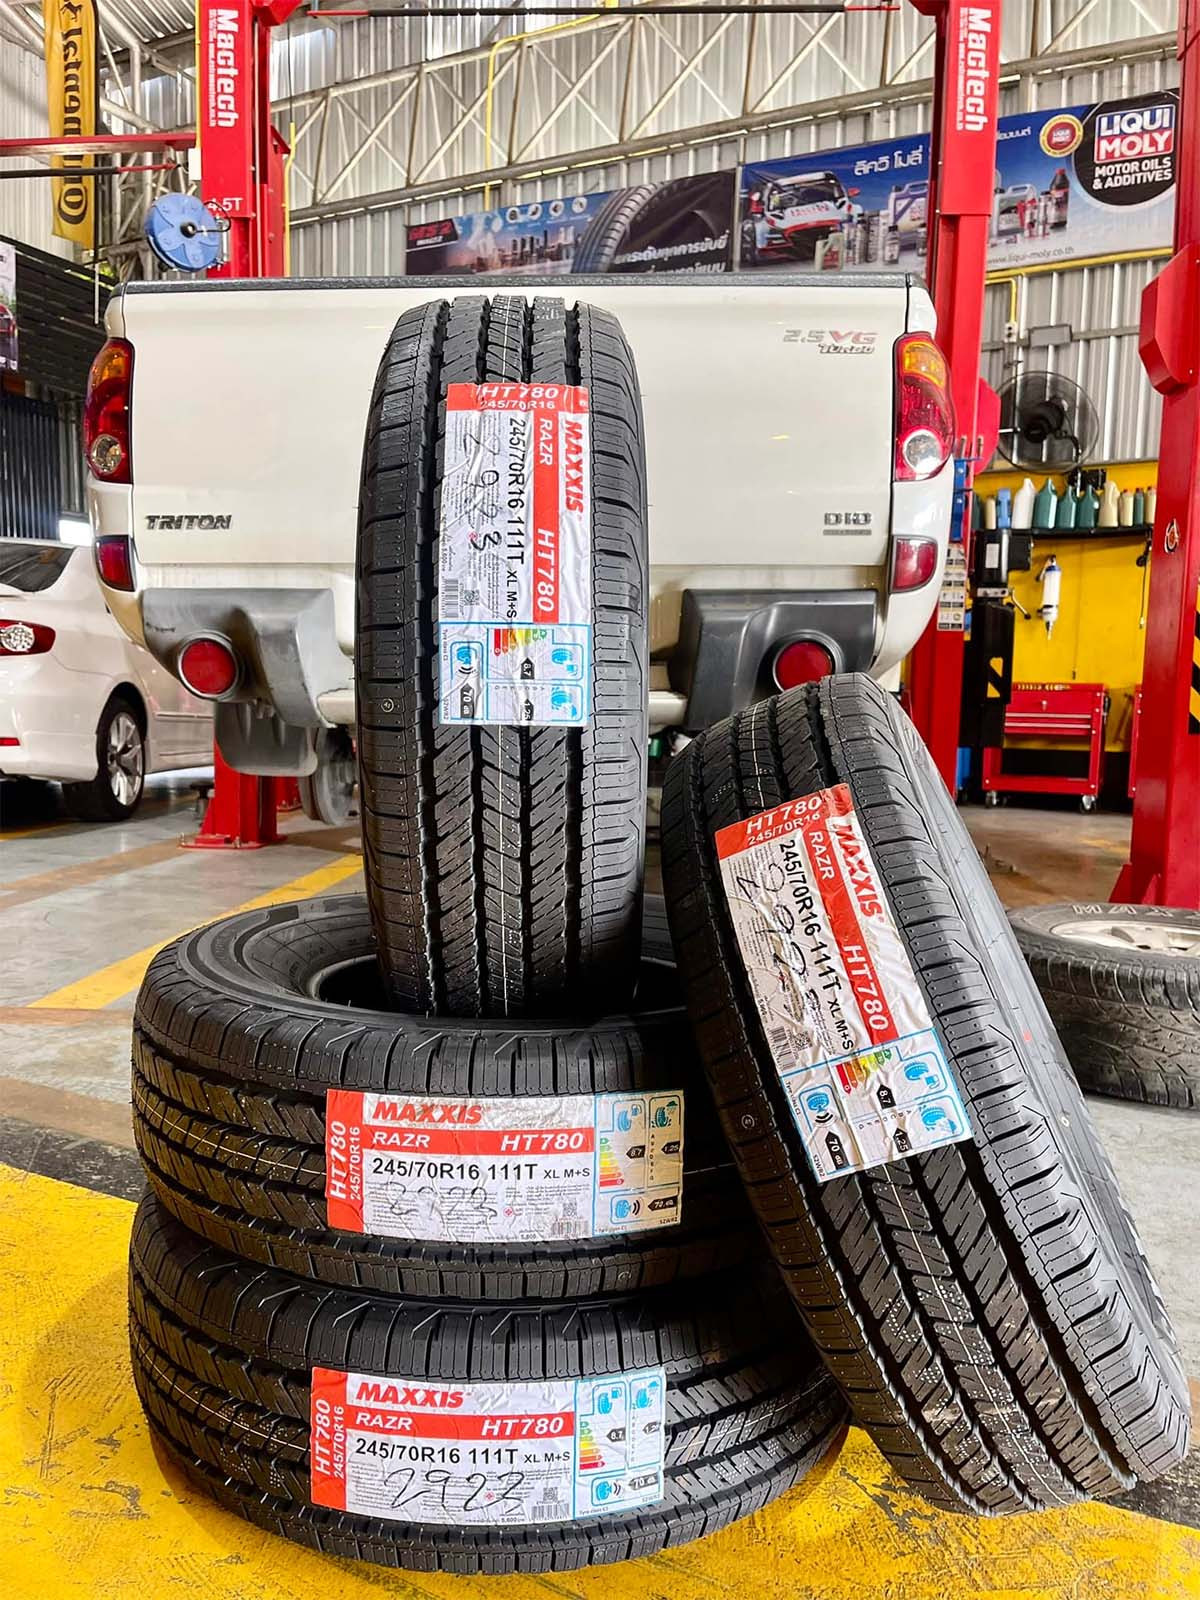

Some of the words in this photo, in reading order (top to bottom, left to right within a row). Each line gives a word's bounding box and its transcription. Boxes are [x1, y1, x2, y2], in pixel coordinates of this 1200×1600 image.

[216, 9, 239, 127] Mactech
[964, 8, 992, 131] Mactech
[1100, 108, 1171, 136] LIQUI
[1100, 130, 1172, 160] MOLY
[1092, 178, 1103, 190] &
[1104, 169, 1172, 188] ADDITIVES
[1095, 161, 1140, 178] MOTOR
[1141, 157, 1172, 170] OILS
[481, 386, 559, 399] HT780
[539, 418, 553, 465] RAZR
[507, 418, 526, 509] 245/70R16
[565, 420, 584, 513] MAXXIS
[145, 514, 233, 530] TRITON
[507, 516, 525, 564] 111T
[506, 570, 517, 586] XL
[537, 528, 555, 612] HT780
[506, 591, 517, 618] M+S
[462, 691, 472, 703] 70
[746, 796, 823, 835] HT780
[747, 812, 821, 845] 245/70R16
[834, 823, 883, 918] MAXXIS
[780, 839, 822, 937] 245/70R16
[808, 831, 836, 880] RAZR
[843, 945, 889, 1030] HT780
[811, 941, 842, 991] 111T
[828, 998, 842, 1018] XL
[834, 1020, 854, 1050] M+S
[879, 1089, 891, 1104] 8.7
[372, 1101, 483, 1125] MAXXIS
[372, 1131, 431, 1148] RAZR
[500, 1132, 584, 1151] HT780
[828, 1138, 839, 1152] 70
[894, 1131, 908, 1151] 1.25
[330, 1120, 347, 1199] HT780
[349, 1126, 361, 1200] 245/70R16
[372, 1157, 480, 1180] 245/70R16
[487, 1163, 538, 1181] 111T
[543, 1169, 560, 1180] XL
[563, 1167, 591, 1178] M+S
[356, 1382, 465, 1409] MAXXIS
[315, 1399, 330, 1475] HT780
[355, 1412, 413, 1431] RAZR
[481, 1416, 564, 1436] HT780
[333, 1405, 345, 1479] 245/70R16
[356, 1437, 461, 1464] 245/70R16
[468, 1448, 519, 1464] 111T
[524, 1454, 540, 1464] XL
[544, 1451, 570, 1463] M+S
[634, 1479, 645, 1489] 70
